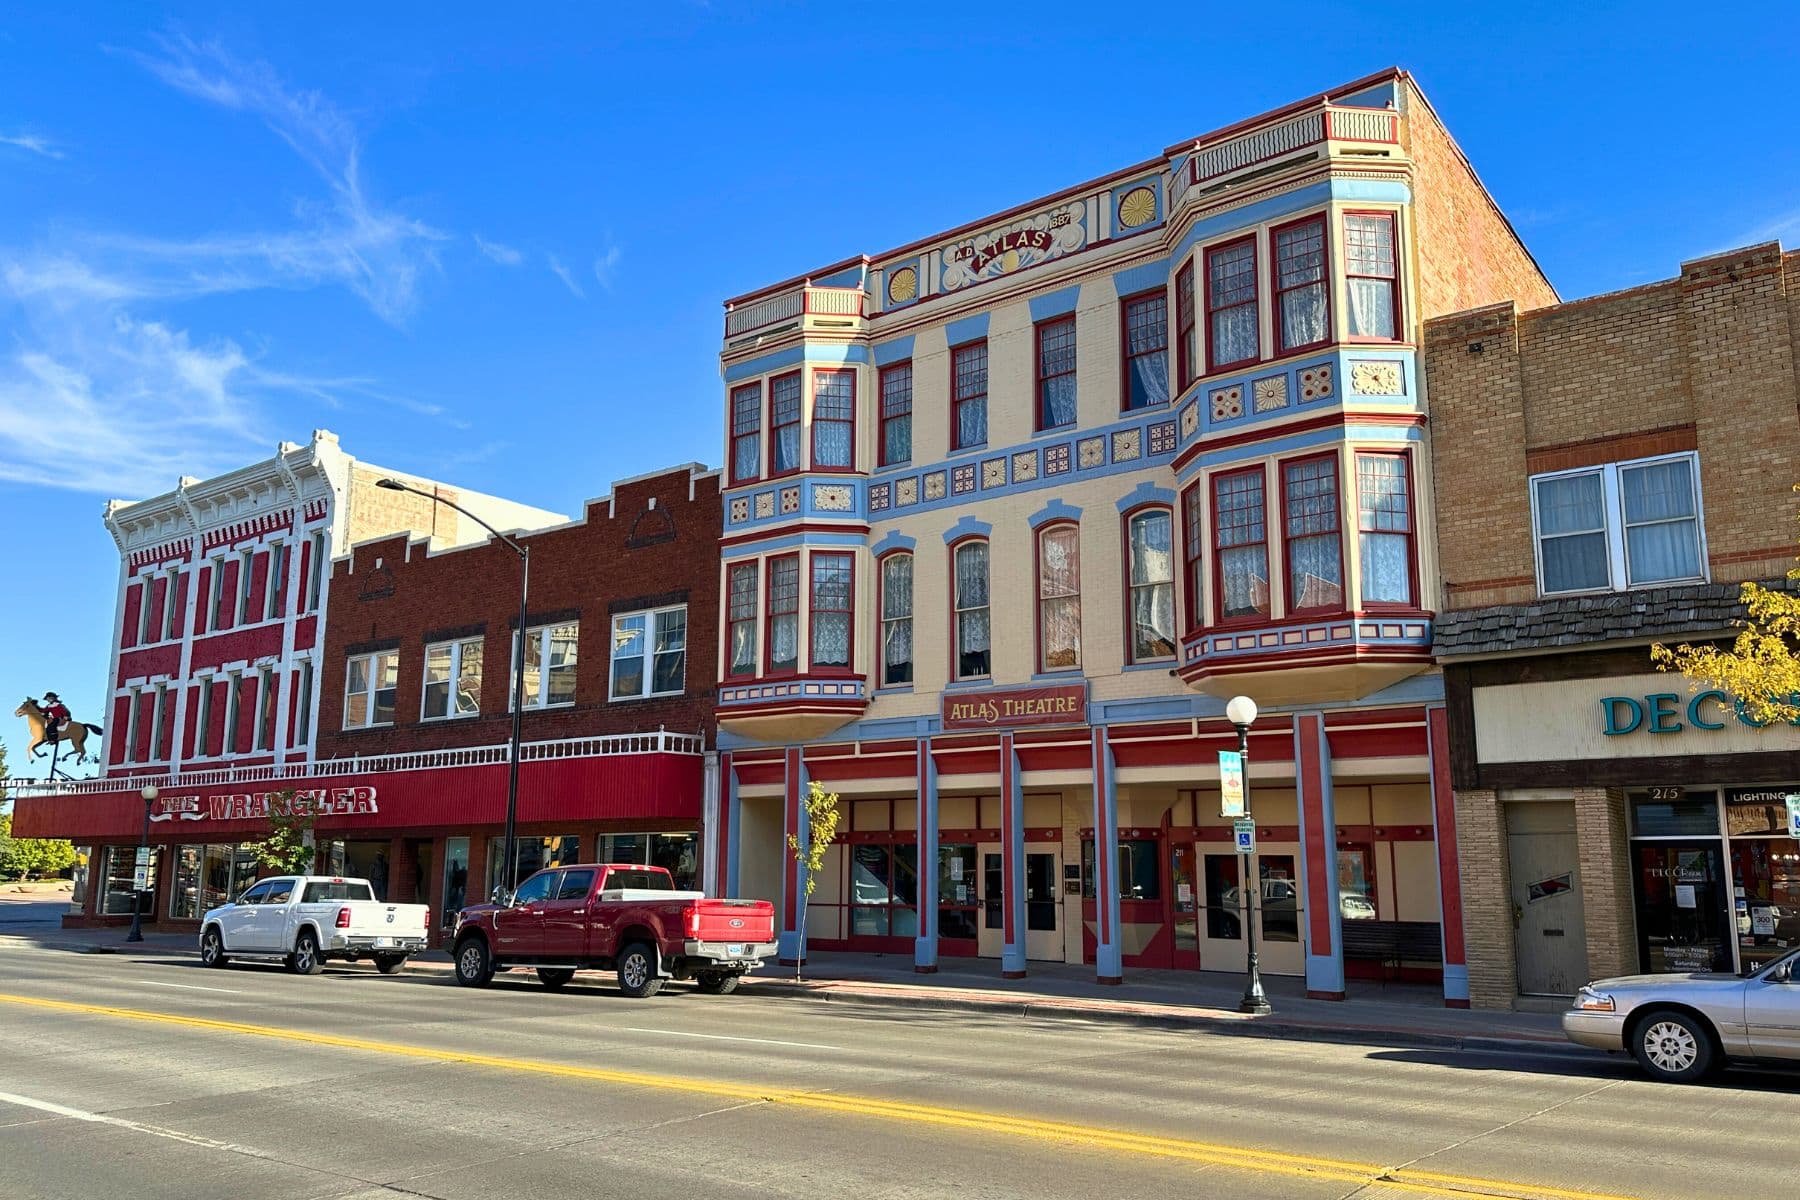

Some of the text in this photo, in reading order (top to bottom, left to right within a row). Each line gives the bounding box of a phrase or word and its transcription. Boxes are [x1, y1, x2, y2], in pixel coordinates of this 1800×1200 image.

[978, 231, 1046, 267] ATLAS
[950, 696, 1078, 724] ATLAS THEATRE
[161, 787, 379, 820] THE WRANGLER
[1652, 787, 1679, 800] 215
[1733, 791, 1786, 802] LIGHTING
